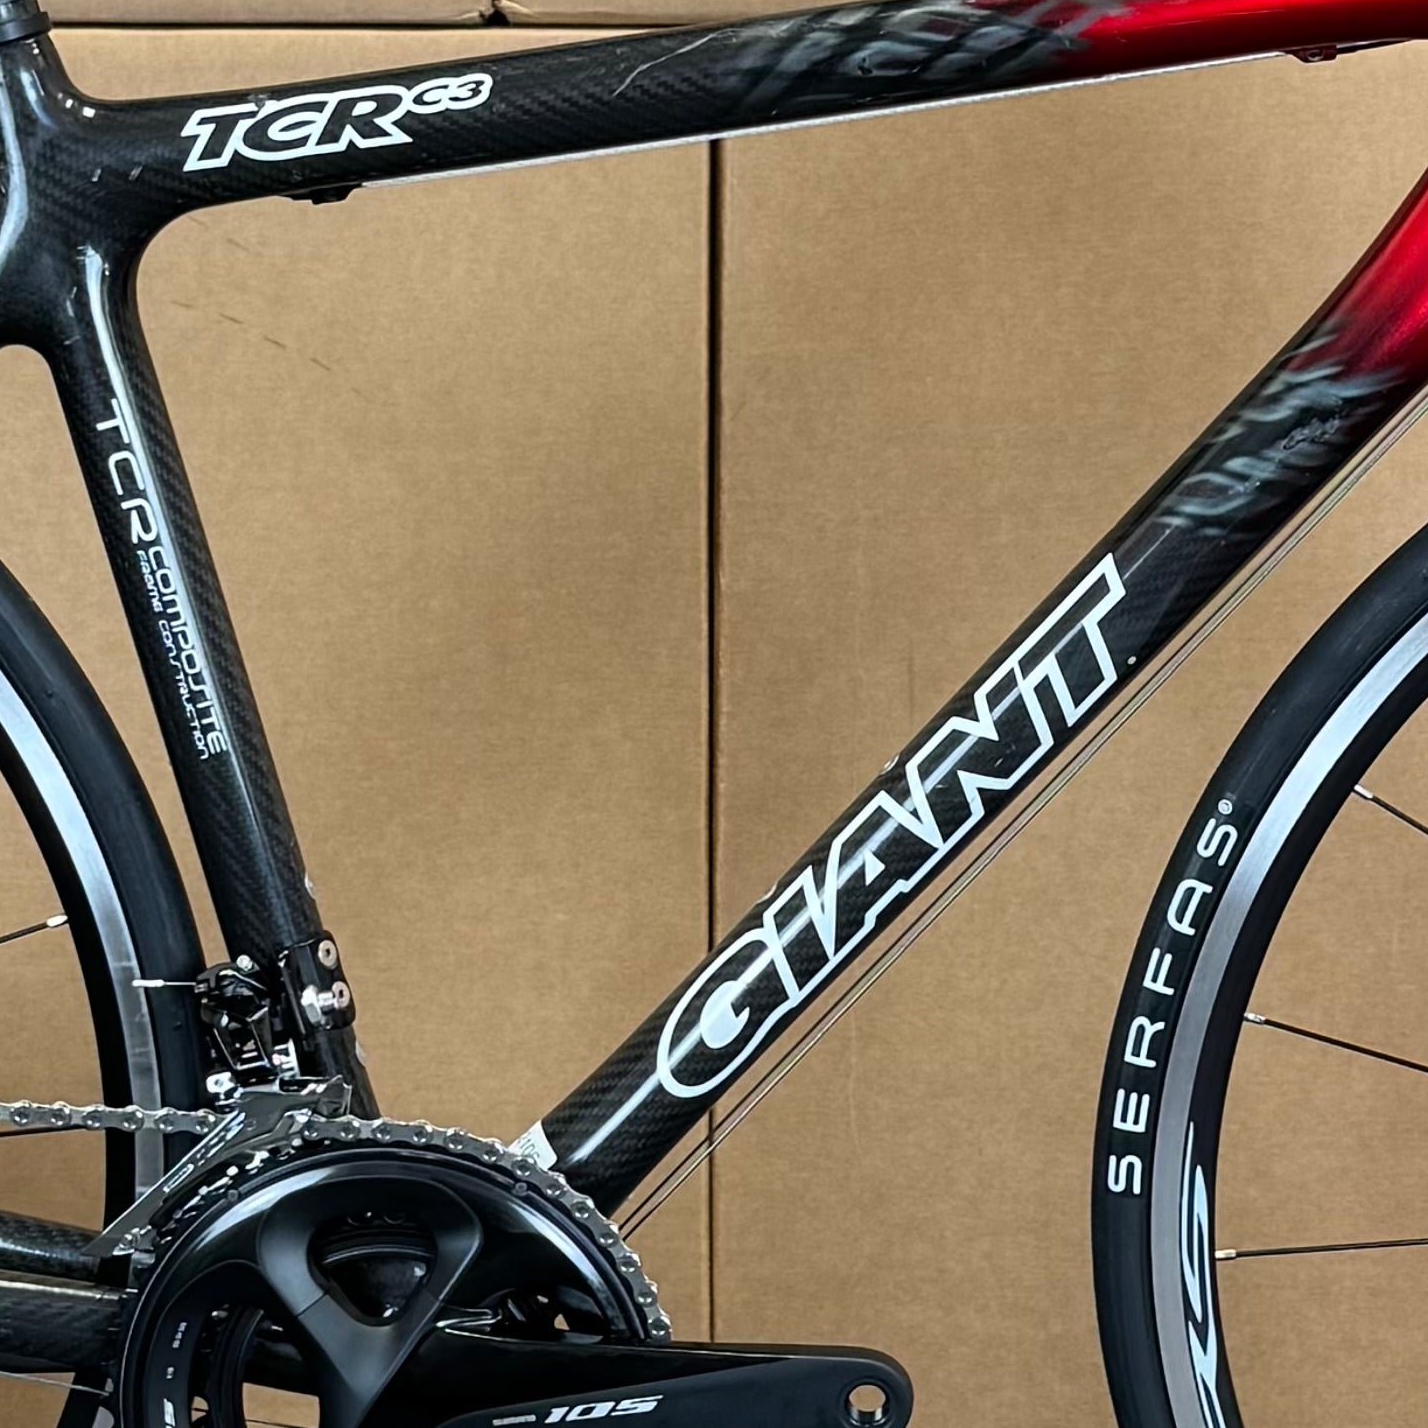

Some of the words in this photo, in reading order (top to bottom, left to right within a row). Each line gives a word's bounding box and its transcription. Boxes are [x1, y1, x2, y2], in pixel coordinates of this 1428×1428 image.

[181, 83, 413, 172] TCR
[96, 399, 159, 544] TCR
[149, 545, 227, 756] COMPOSITE
[657, 552, 1126, 1098] GIANT
[543, 1394, 664, 1424] 105
